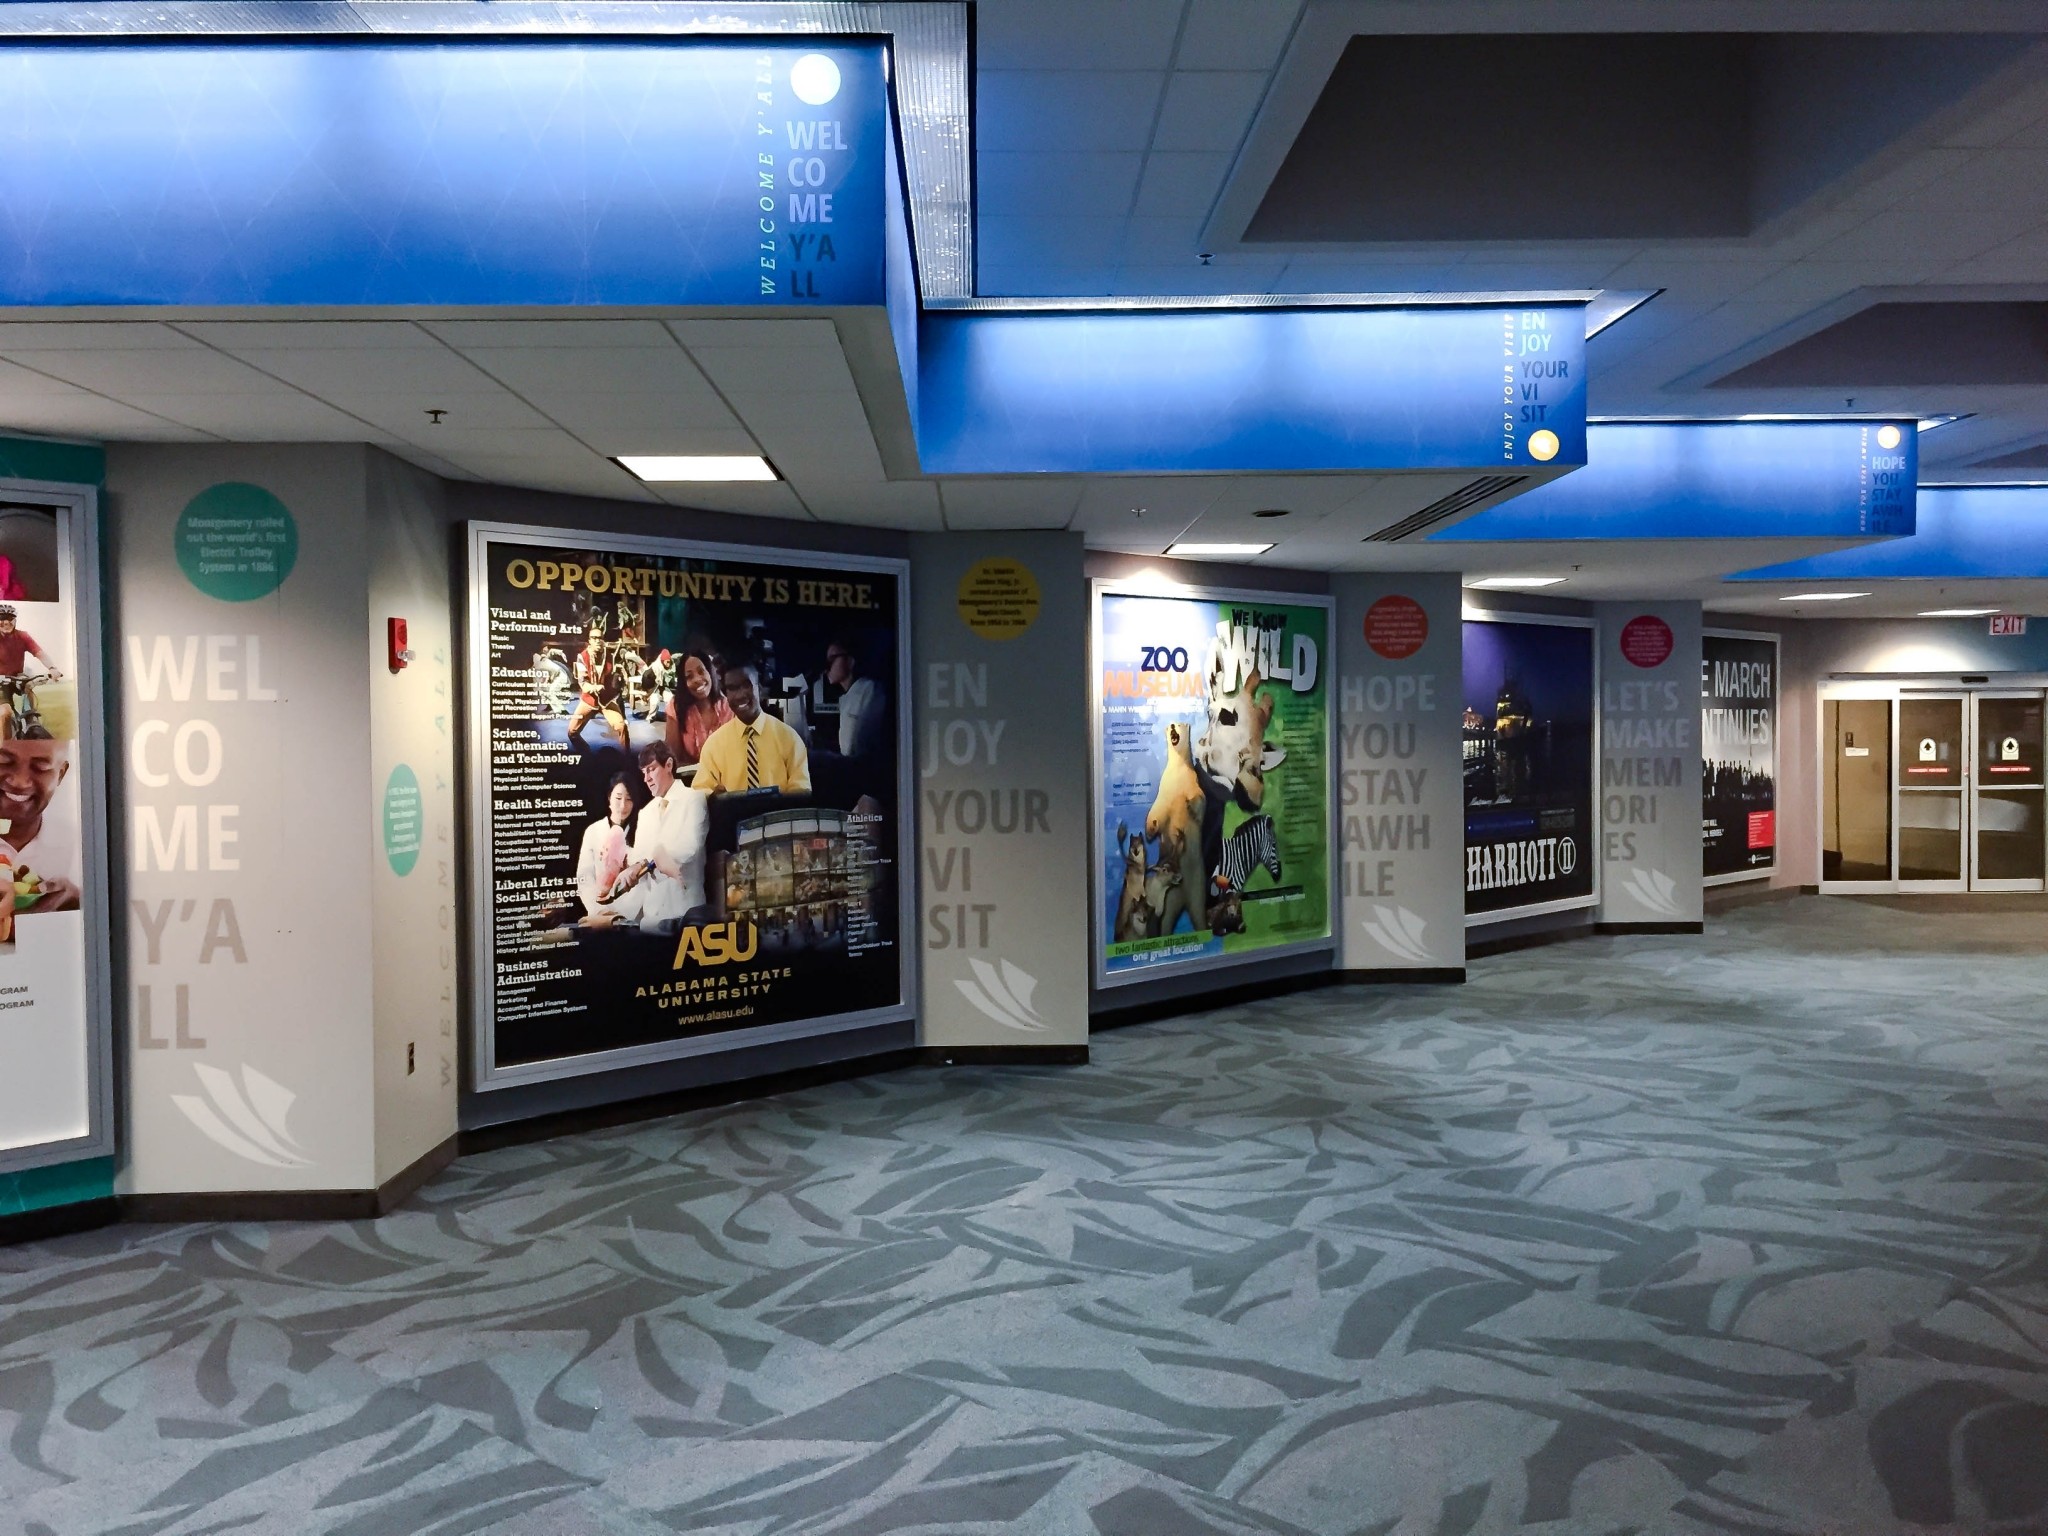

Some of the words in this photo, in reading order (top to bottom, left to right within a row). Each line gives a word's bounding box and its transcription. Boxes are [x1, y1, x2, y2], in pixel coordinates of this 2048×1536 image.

[786, 121, 847, 150] WEL
[787, 157, 826, 188] CO
[789, 193, 833, 223] ME
[758, 153, 776, 296] WELCOME
[791, 270, 820, 299] LL
[1504, 313, 1514, 356] VISIT
[1522, 312, 1546, 331] EN
[1519, 334, 1552, 357] JOY
[1521, 361, 1569, 379] YOUR
[1504, 365, 1513, 405] YOUR
[1521, 383, 1538, 401] VI
[1521, 405, 1547, 423] SIT
[1504, 413, 1514, 459] ENJOY
[1872, 457, 1906, 470] HOPE
[1873, 473, 1899, 485] YOU
[1872, 489, 1902, 502] STAY
[187, 518, 252, 530] Montgomery
[186, 534, 204, 542] out
[206, 533, 224, 542] the
[201, 547, 236, 557] Electric
[239, 547, 272, 559] Trolley
[199, 562, 235, 574] System
[238, 563, 248, 572] in
[506, 558, 756, 603] OPPORTUNITY
[763, 577, 790, 604] IS
[797, 580, 880, 610] HERE.
[490, 608, 527, 619] Visual
[530, 610, 551, 621] and
[1232, 609, 1249, 626] WE
[1253, 610, 1288, 632] KNOW
[1992, 617, 2023, 634] EXIT
[491, 621, 557, 635] Performing
[559, 623, 582, 634] Arts
[127, 635, 279, 702] WEL
[1141, 646, 1189, 673] ZOO
[1216, 619, 1318, 693] WILD
[491, 667, 550, 678] Education
[1103, 670, 1205, 698] MUSEUM
[1715, 661, 1771, 699] MARCH
[927, 663, 988, 709] EN
[1341, 674, 1436, 712] HOPE
[493, 728, 541, 740] Science,
[1605, 719, 1690, 750] MAKE
[1702, 708, 1770, 745] NTINUES
[131, 719, 223, 787] CO
[493, 741, 568, 751] Mathematics
[921, 719, 1007, 778] JOY
[1340, 722, 1416, 760] YOU
[493, 754, 515, 764] and
[517, 753, 581, 764] Technology
[1605, 757, 1683, 788] MEM
[1342, 768, 1428, 806] STAY
[494, 799, 532, 810] Health
[535, 798, 583, 809] Sciences
[926, 789, 1052, 835] YOUR
[1605, 795, 1656, 825] ORI
[847, 814, 883, 823] Athletics
[134, 805, 241, 871] ME
[494, 830, 536, 838] Rehabilitation
[1343, 814, 1431, 851] AWH
[1606, 832, 1637, 862] ES
[926, 847, 972, 892] VI
[1466, 837, 1557, 892] HARRIOTT
[495, 878, 538, 891] Liberal
[540, 876, 563, 887] Arts
[566, 876, 586, 885] and
[1344, 860, 1395, 898] ILE
[496, 891, 531, 903] Social
[533, 889, 580, 900] Sciences
[496, 906, 528, 914] Languages
[927, 904, 997, 950] SIT
[437, 824, 450, 1087] WELCOME
[672, 920, 758, 970] ASU
[1115, 946, 1130, 955] two
[1132, 952, 1149, 962] one
[1150, 948, 1171, 961] great
[1172, 944, 1204, 956] location
[496, 960, 549, 973] Business
[496, 968, 583, 986] Administration
[497, 986, 536, 996] Management
[635, 976, 729, 998] ALABAMA
[738, 967, 792, 984] STATE
[497, 996, 528, 1005] Marketing
[497, 1004, 531, 1013] Accounting
[545, 999, 568, 1007] Finance
[658, 984, 771, 1009] UNIVERSITY
[138, 984, 207, 1050] LL
[497, 1013, 527, 1022] Computer
[528, 1009, 562, 1018] Information
[563, 1005, 587, 1013] Systems
[677, 1005, 754, 1025] www.alasu.edu
